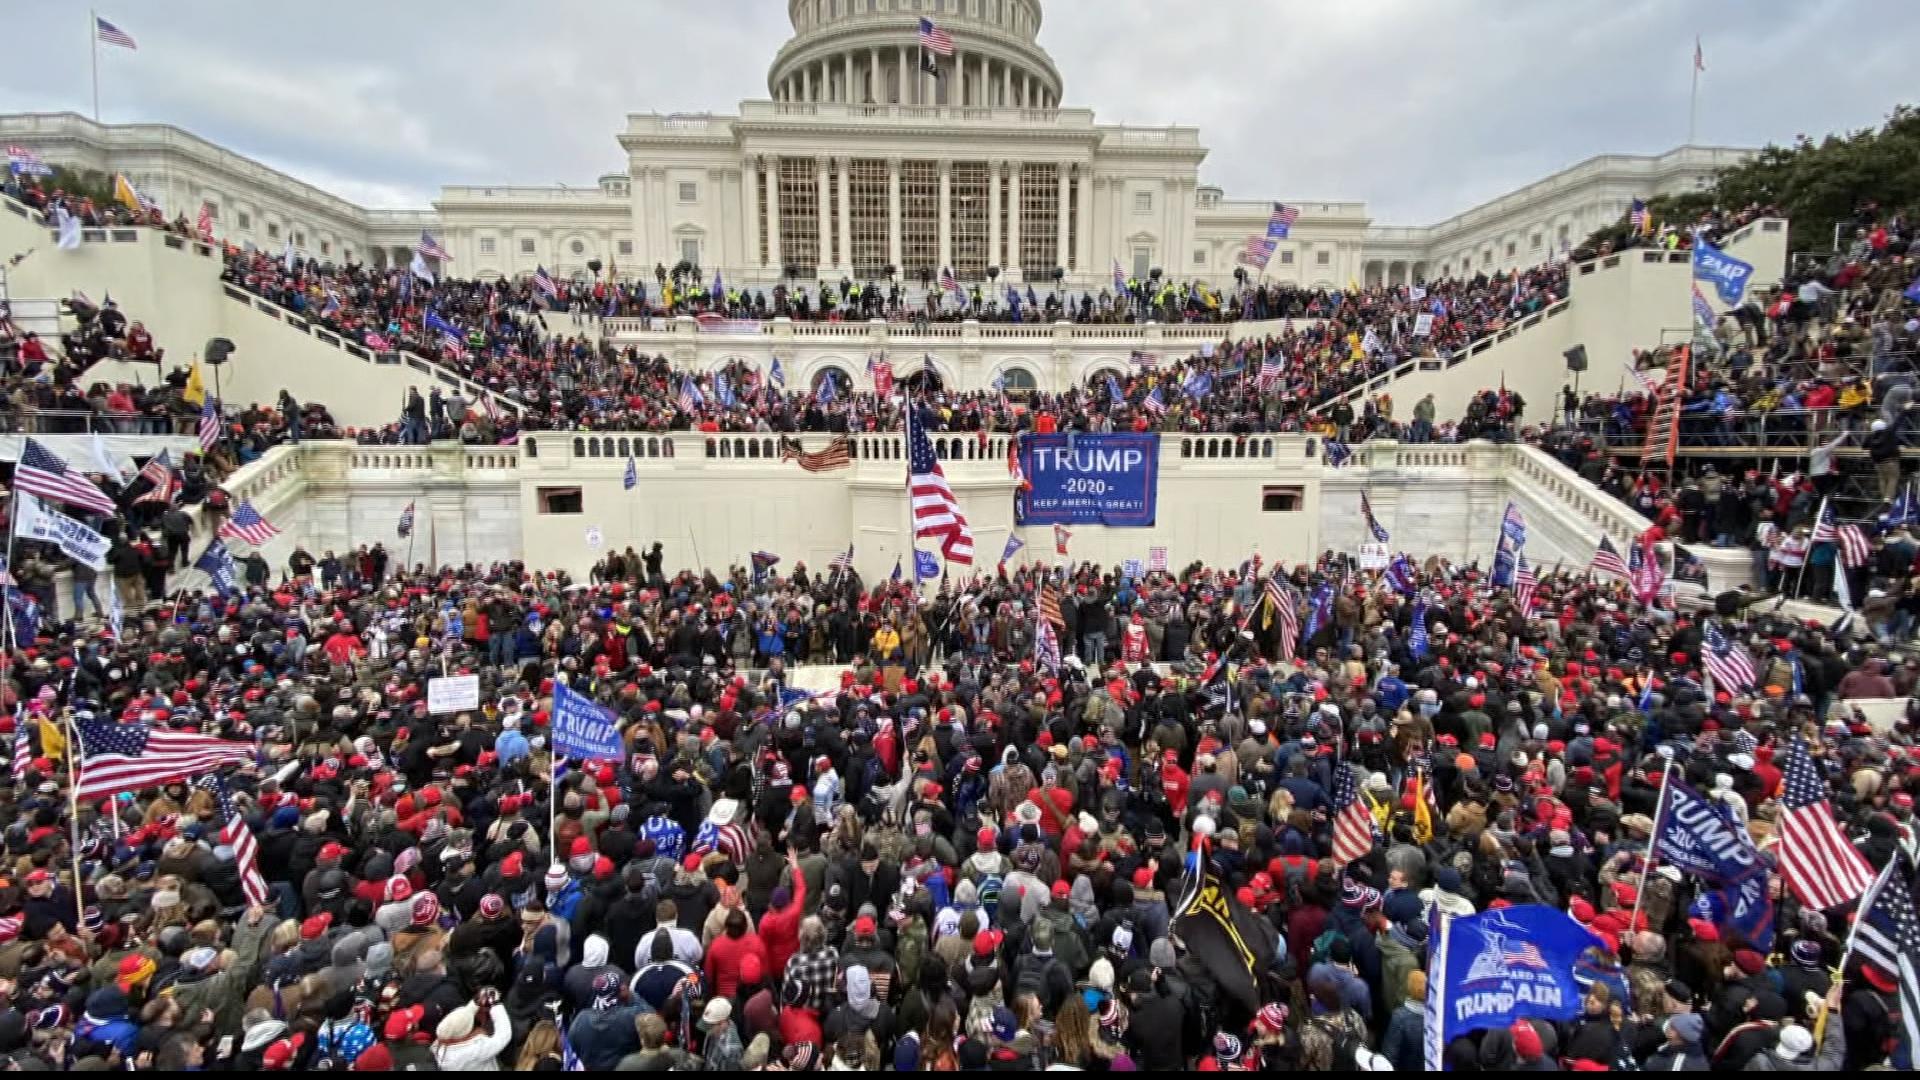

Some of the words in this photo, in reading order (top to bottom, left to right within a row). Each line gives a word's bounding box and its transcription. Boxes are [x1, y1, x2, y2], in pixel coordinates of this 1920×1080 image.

[1033, 447, 1142, 472] TRUMP
[1033, 499, 1058, 509] KEEP
[556, 708, 615, 744] TRUMP
[1669, 784, 1755, 866] RUMP
[1455, 992, 1515, 1021] TRUMP
